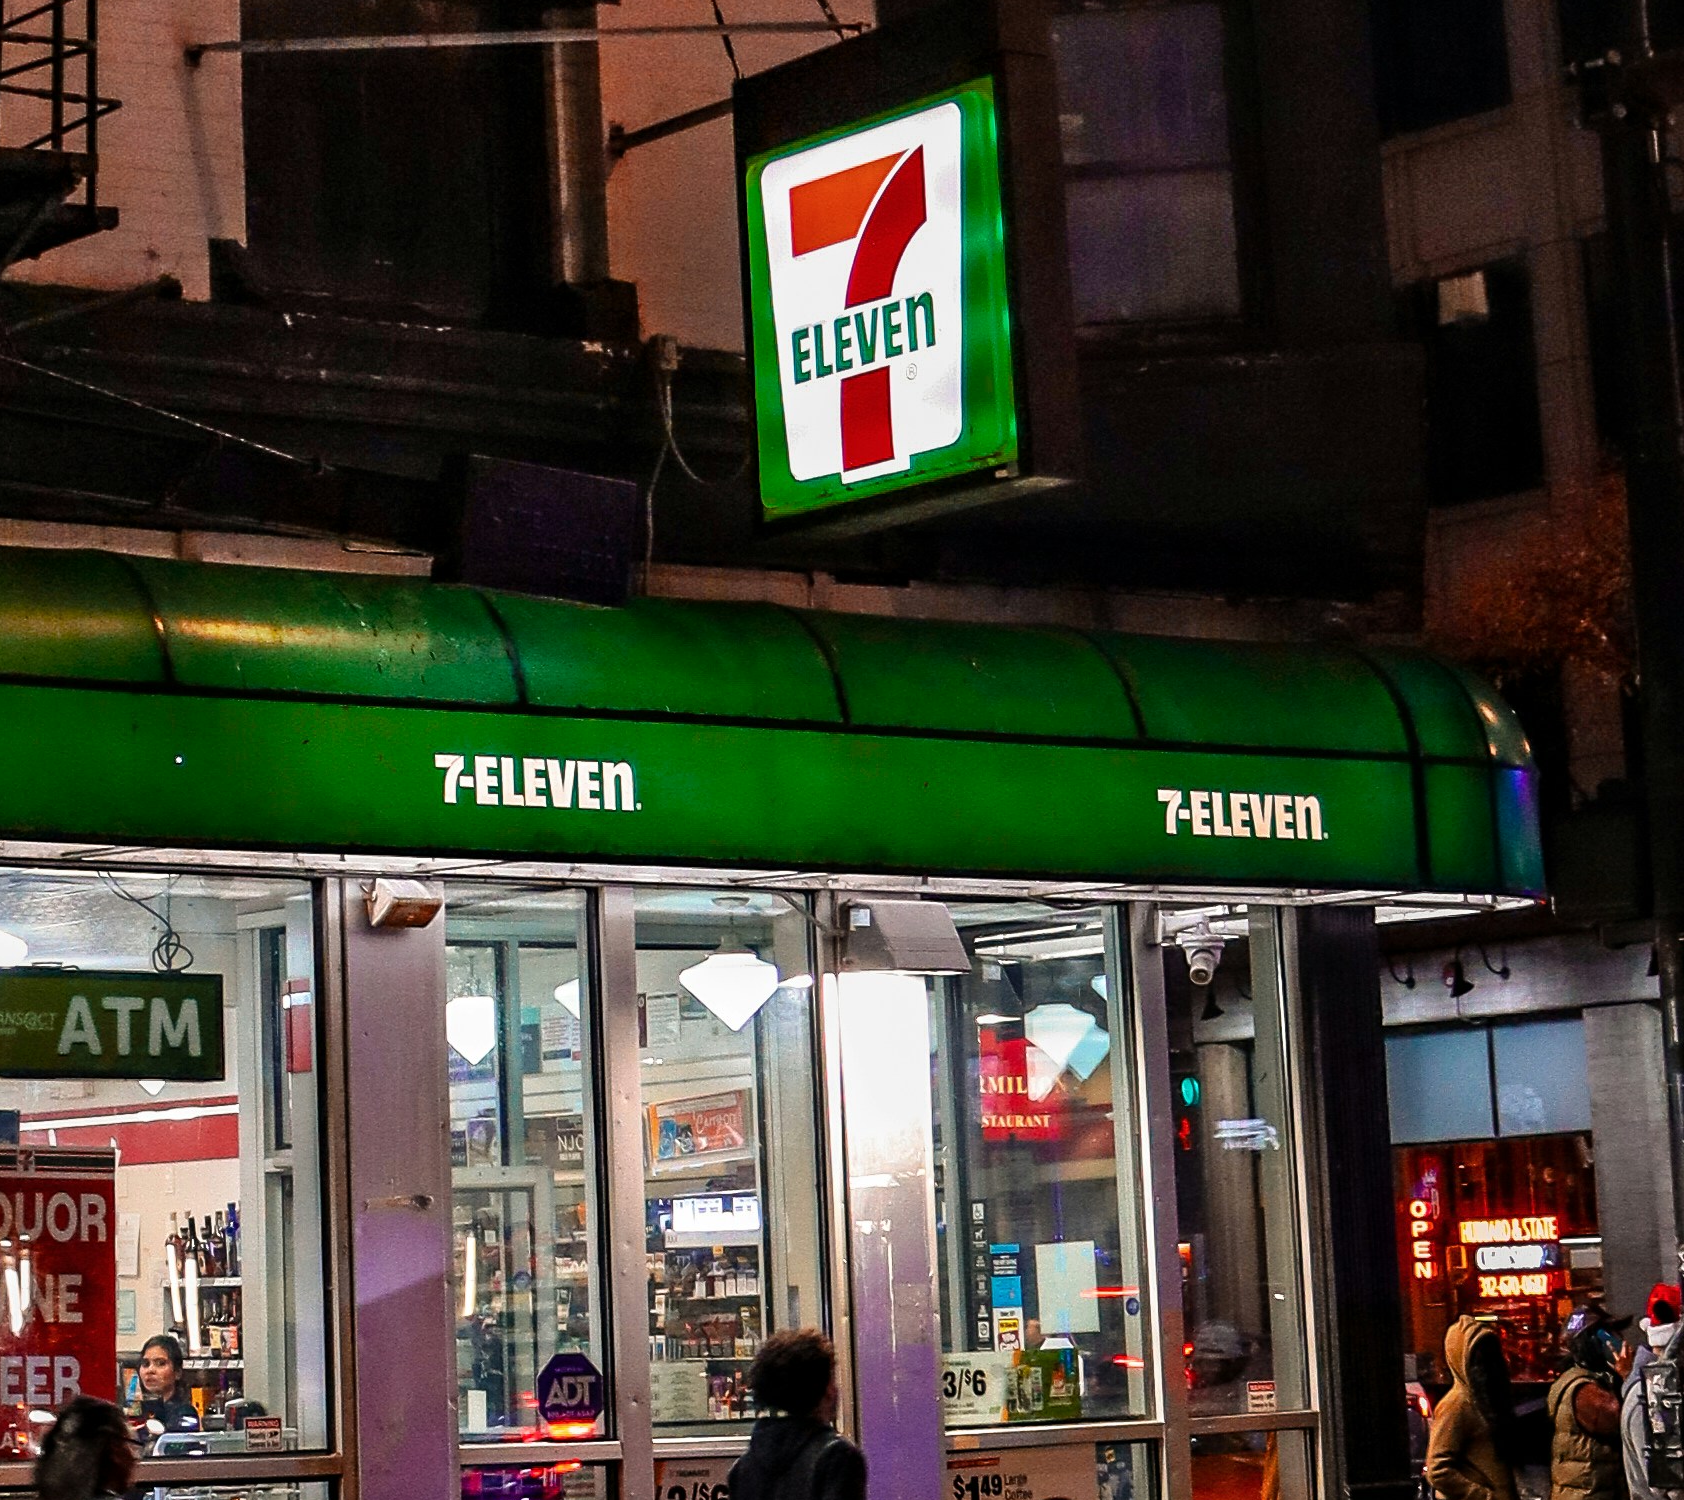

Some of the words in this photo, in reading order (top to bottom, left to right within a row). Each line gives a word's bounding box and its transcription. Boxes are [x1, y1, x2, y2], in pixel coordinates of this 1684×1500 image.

[790, 145, 927, 472] 7
[56, 995, 202, 1057] ATM
[1410, 1200, 1433, 1280] OPEN
[545, 1375, 595, 1408] ADT
[942, 1368, 987, 1400] 3/$6
